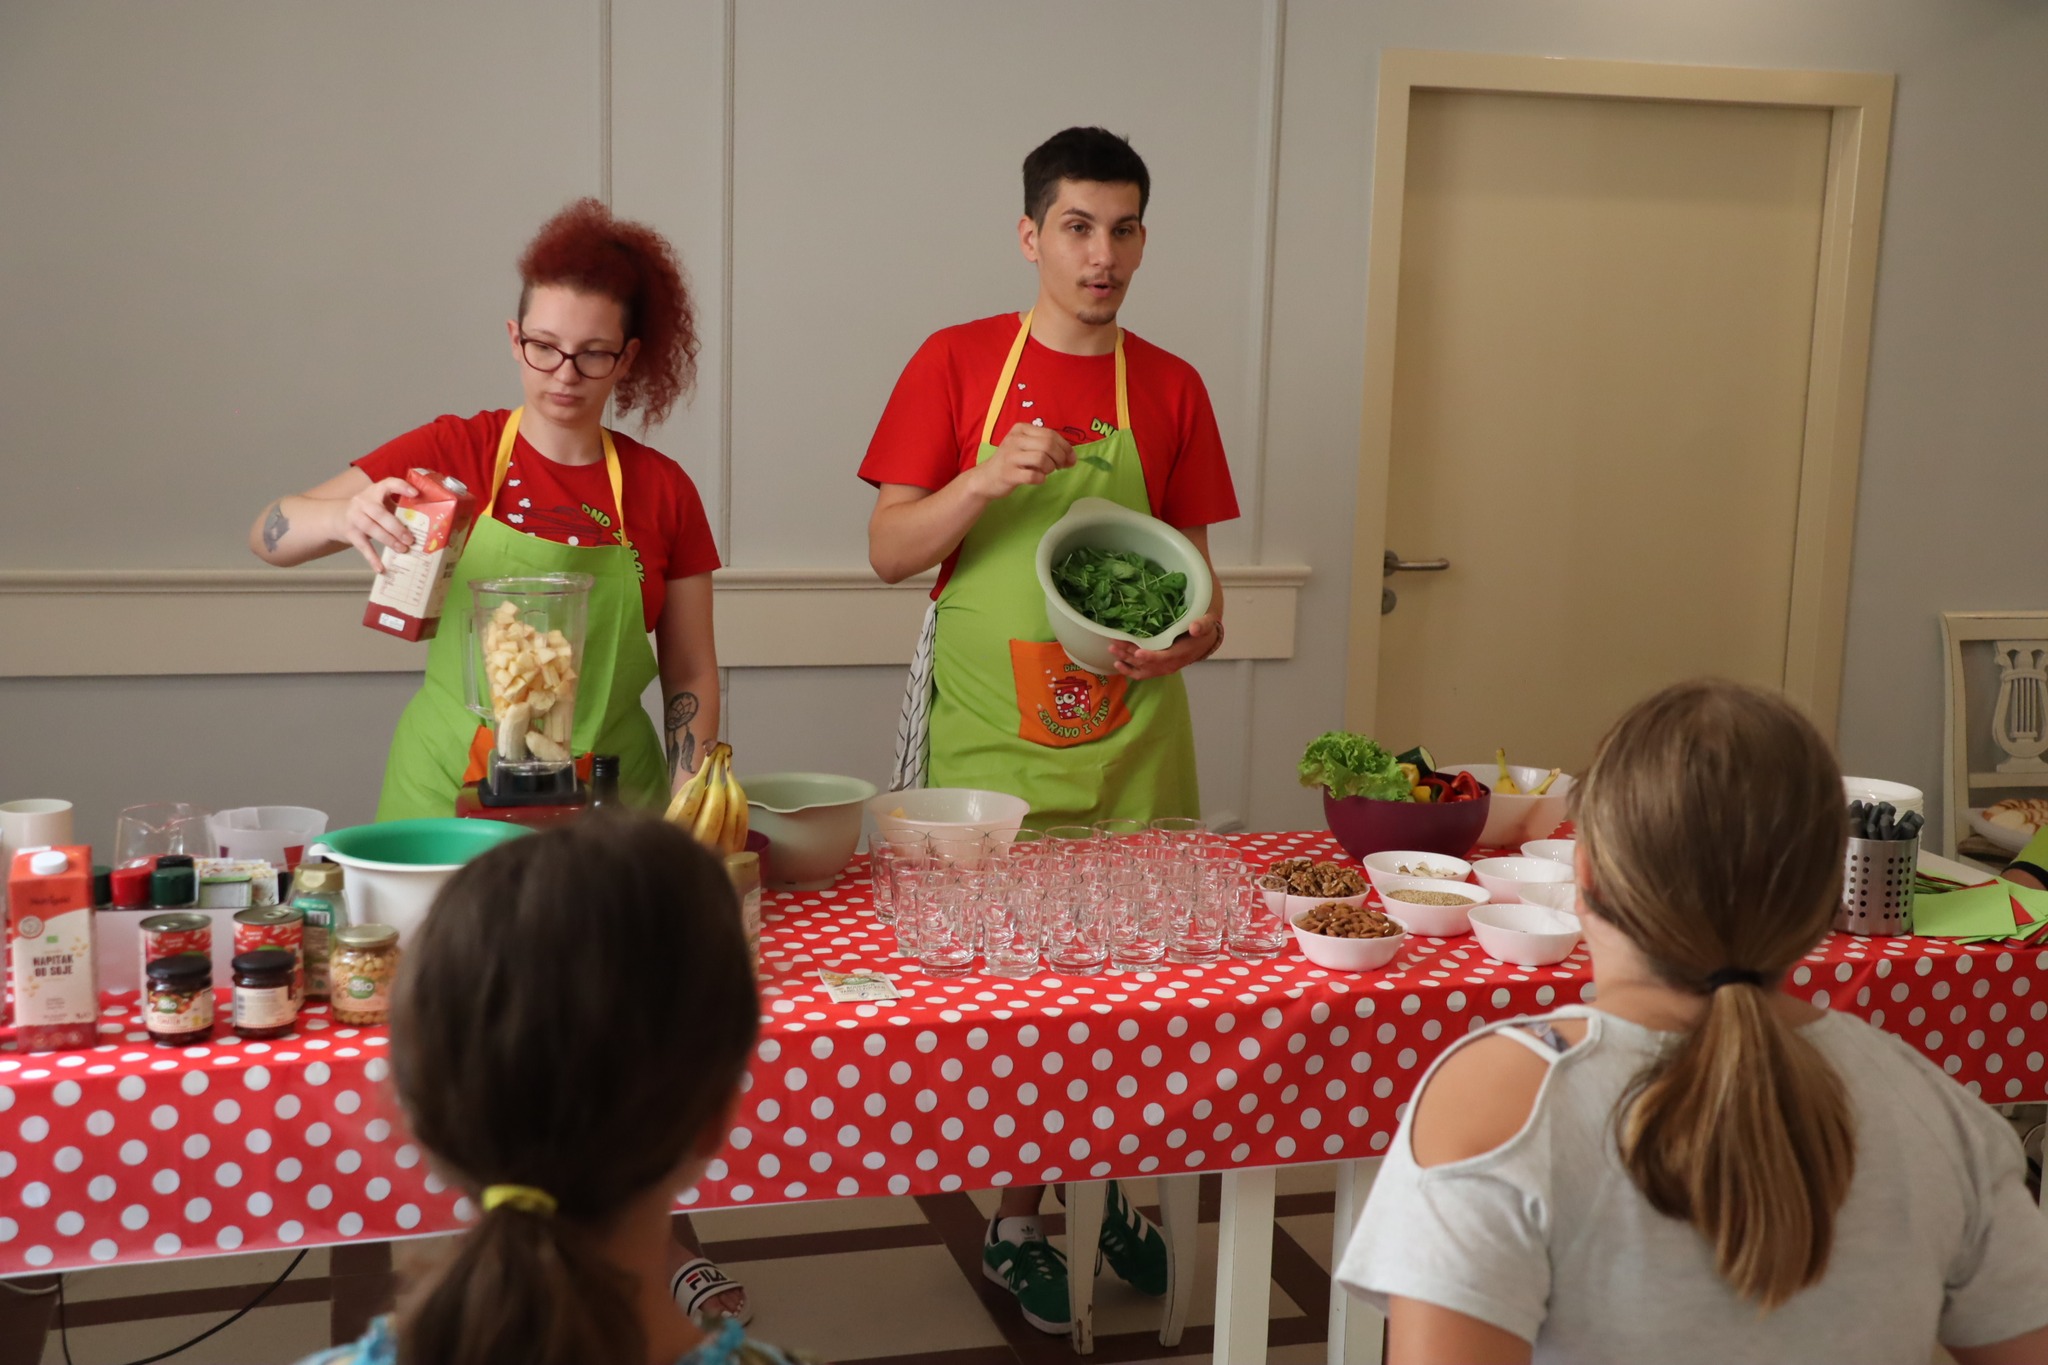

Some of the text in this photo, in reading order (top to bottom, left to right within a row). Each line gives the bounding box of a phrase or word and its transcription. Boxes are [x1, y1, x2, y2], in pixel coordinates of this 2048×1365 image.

[1091, 417, 1118, 437] DN
[582, 503, 611, 527] DND
[1039, 697, 1110, 737] ZDRAVO I FINO
[33, 954, 74, 966] NAPITAK
[35, 965, 73, 977] OD SOJE
[686, 1269, 727, 1291] FILA
